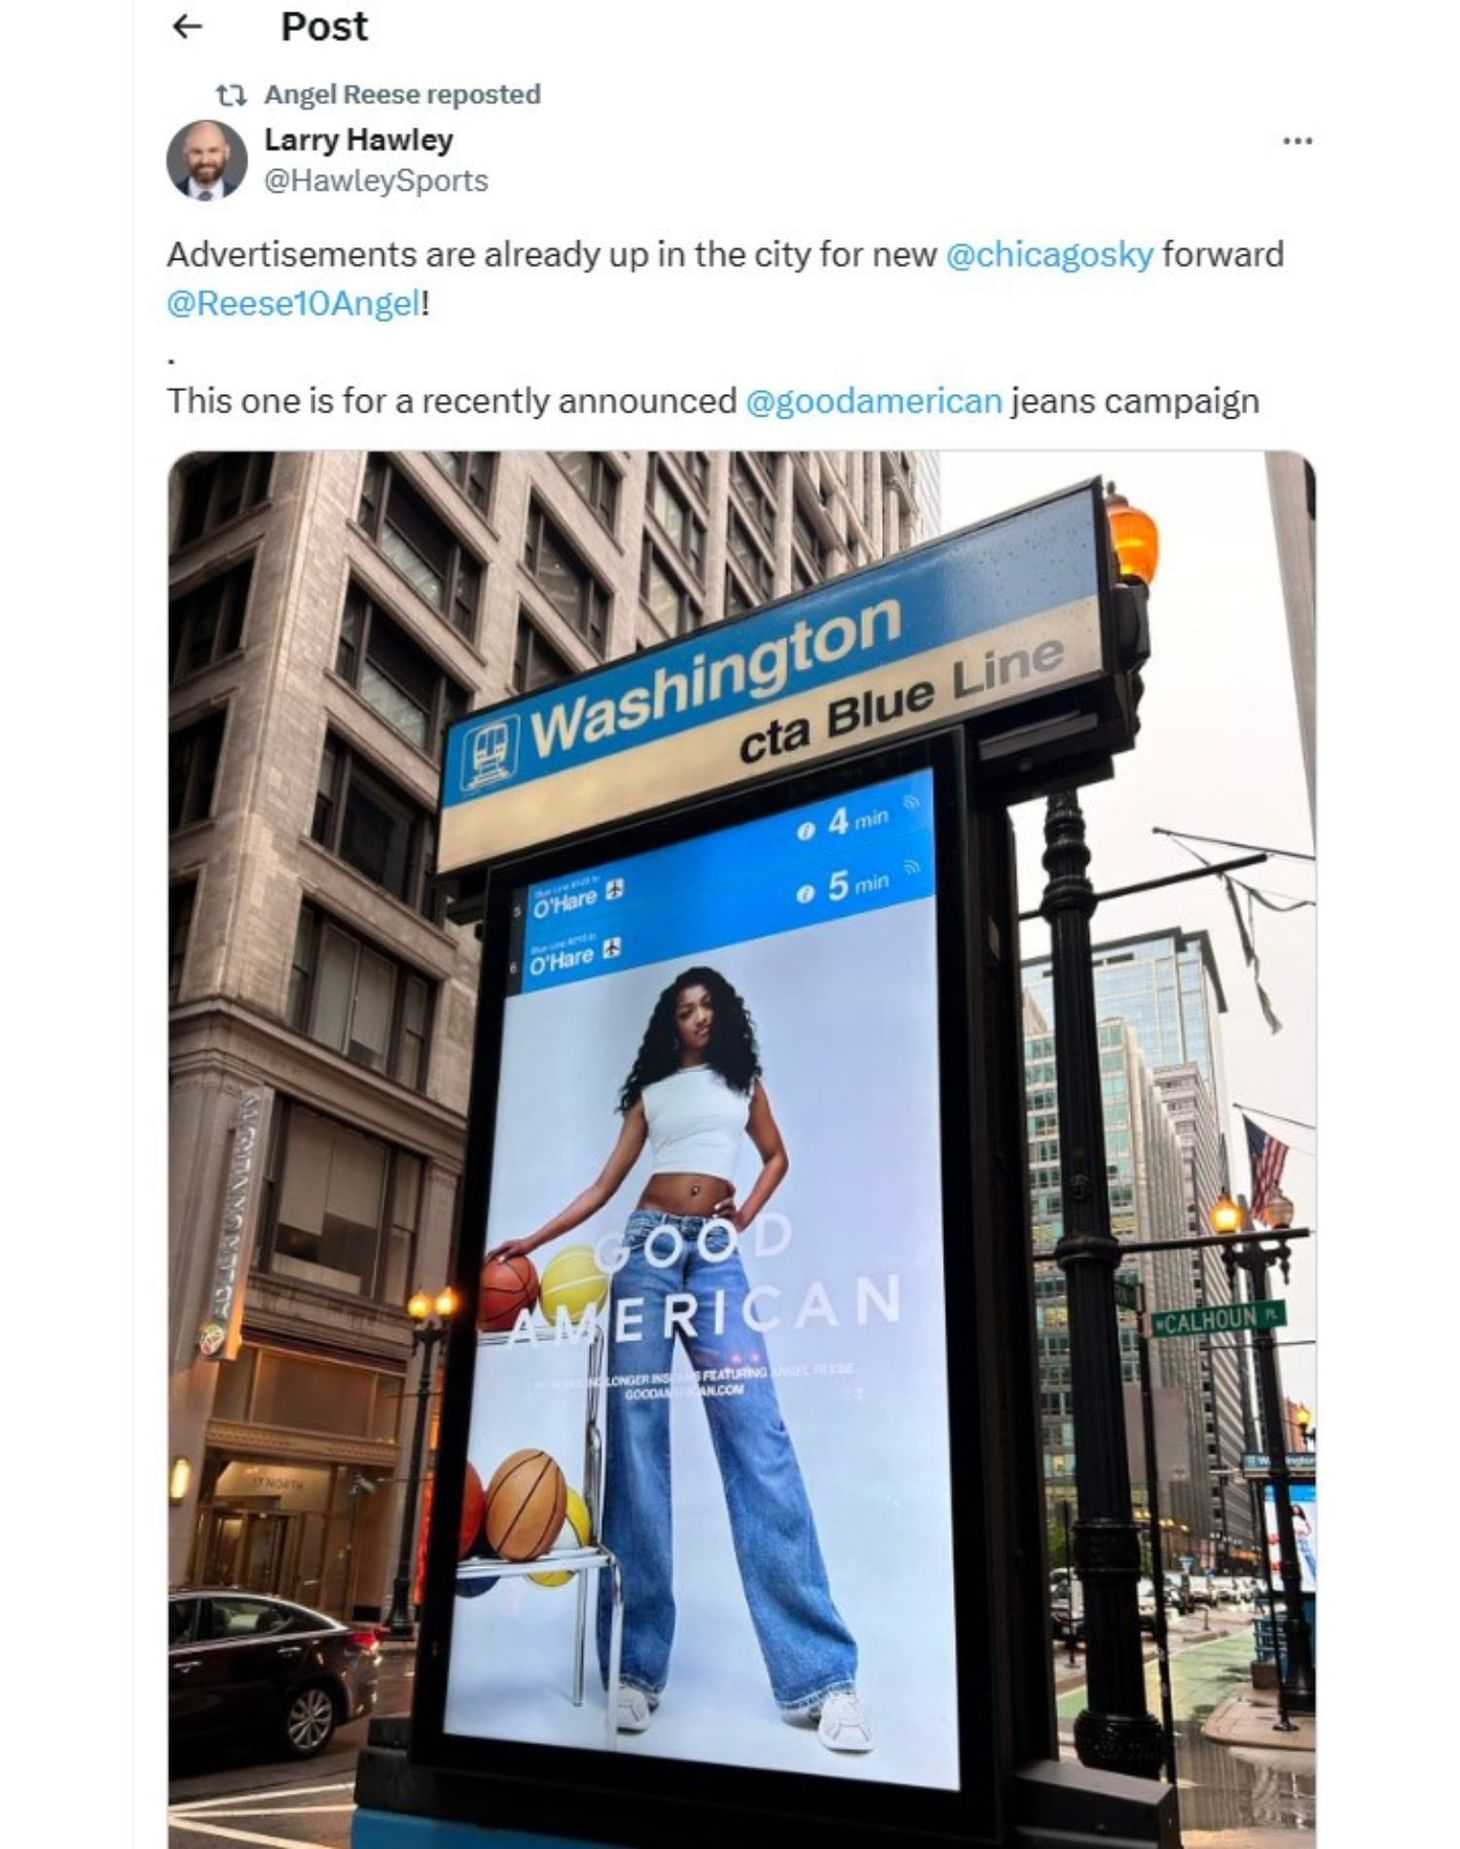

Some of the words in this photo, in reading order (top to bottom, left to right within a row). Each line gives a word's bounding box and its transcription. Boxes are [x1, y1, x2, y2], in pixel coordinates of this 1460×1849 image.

[531, 595, 902, 759] Washington
[740, 714, 810, 766] cta
[827, 680, 935, 738] Blue
[953, 633, 1065, 699] Line
[828, 806, 849, 835] 4
[855, 809, 889, 830] min
[828, 869, 849, 902] 5
[855, 873, 890, 894] min
[533, 890, 598, 919] O'Hare
[529, 948, 595, 975] O'Hare
[593, 1211, 793, 1275] GOOD
[507, 1274, 901, 1349] AMERICAN
[1164, 1305, 1257, 1334] CALHOUN
[607, 1373, 650, 1388] LONGER
[703, 1365, 767, 1382] FEATURING
